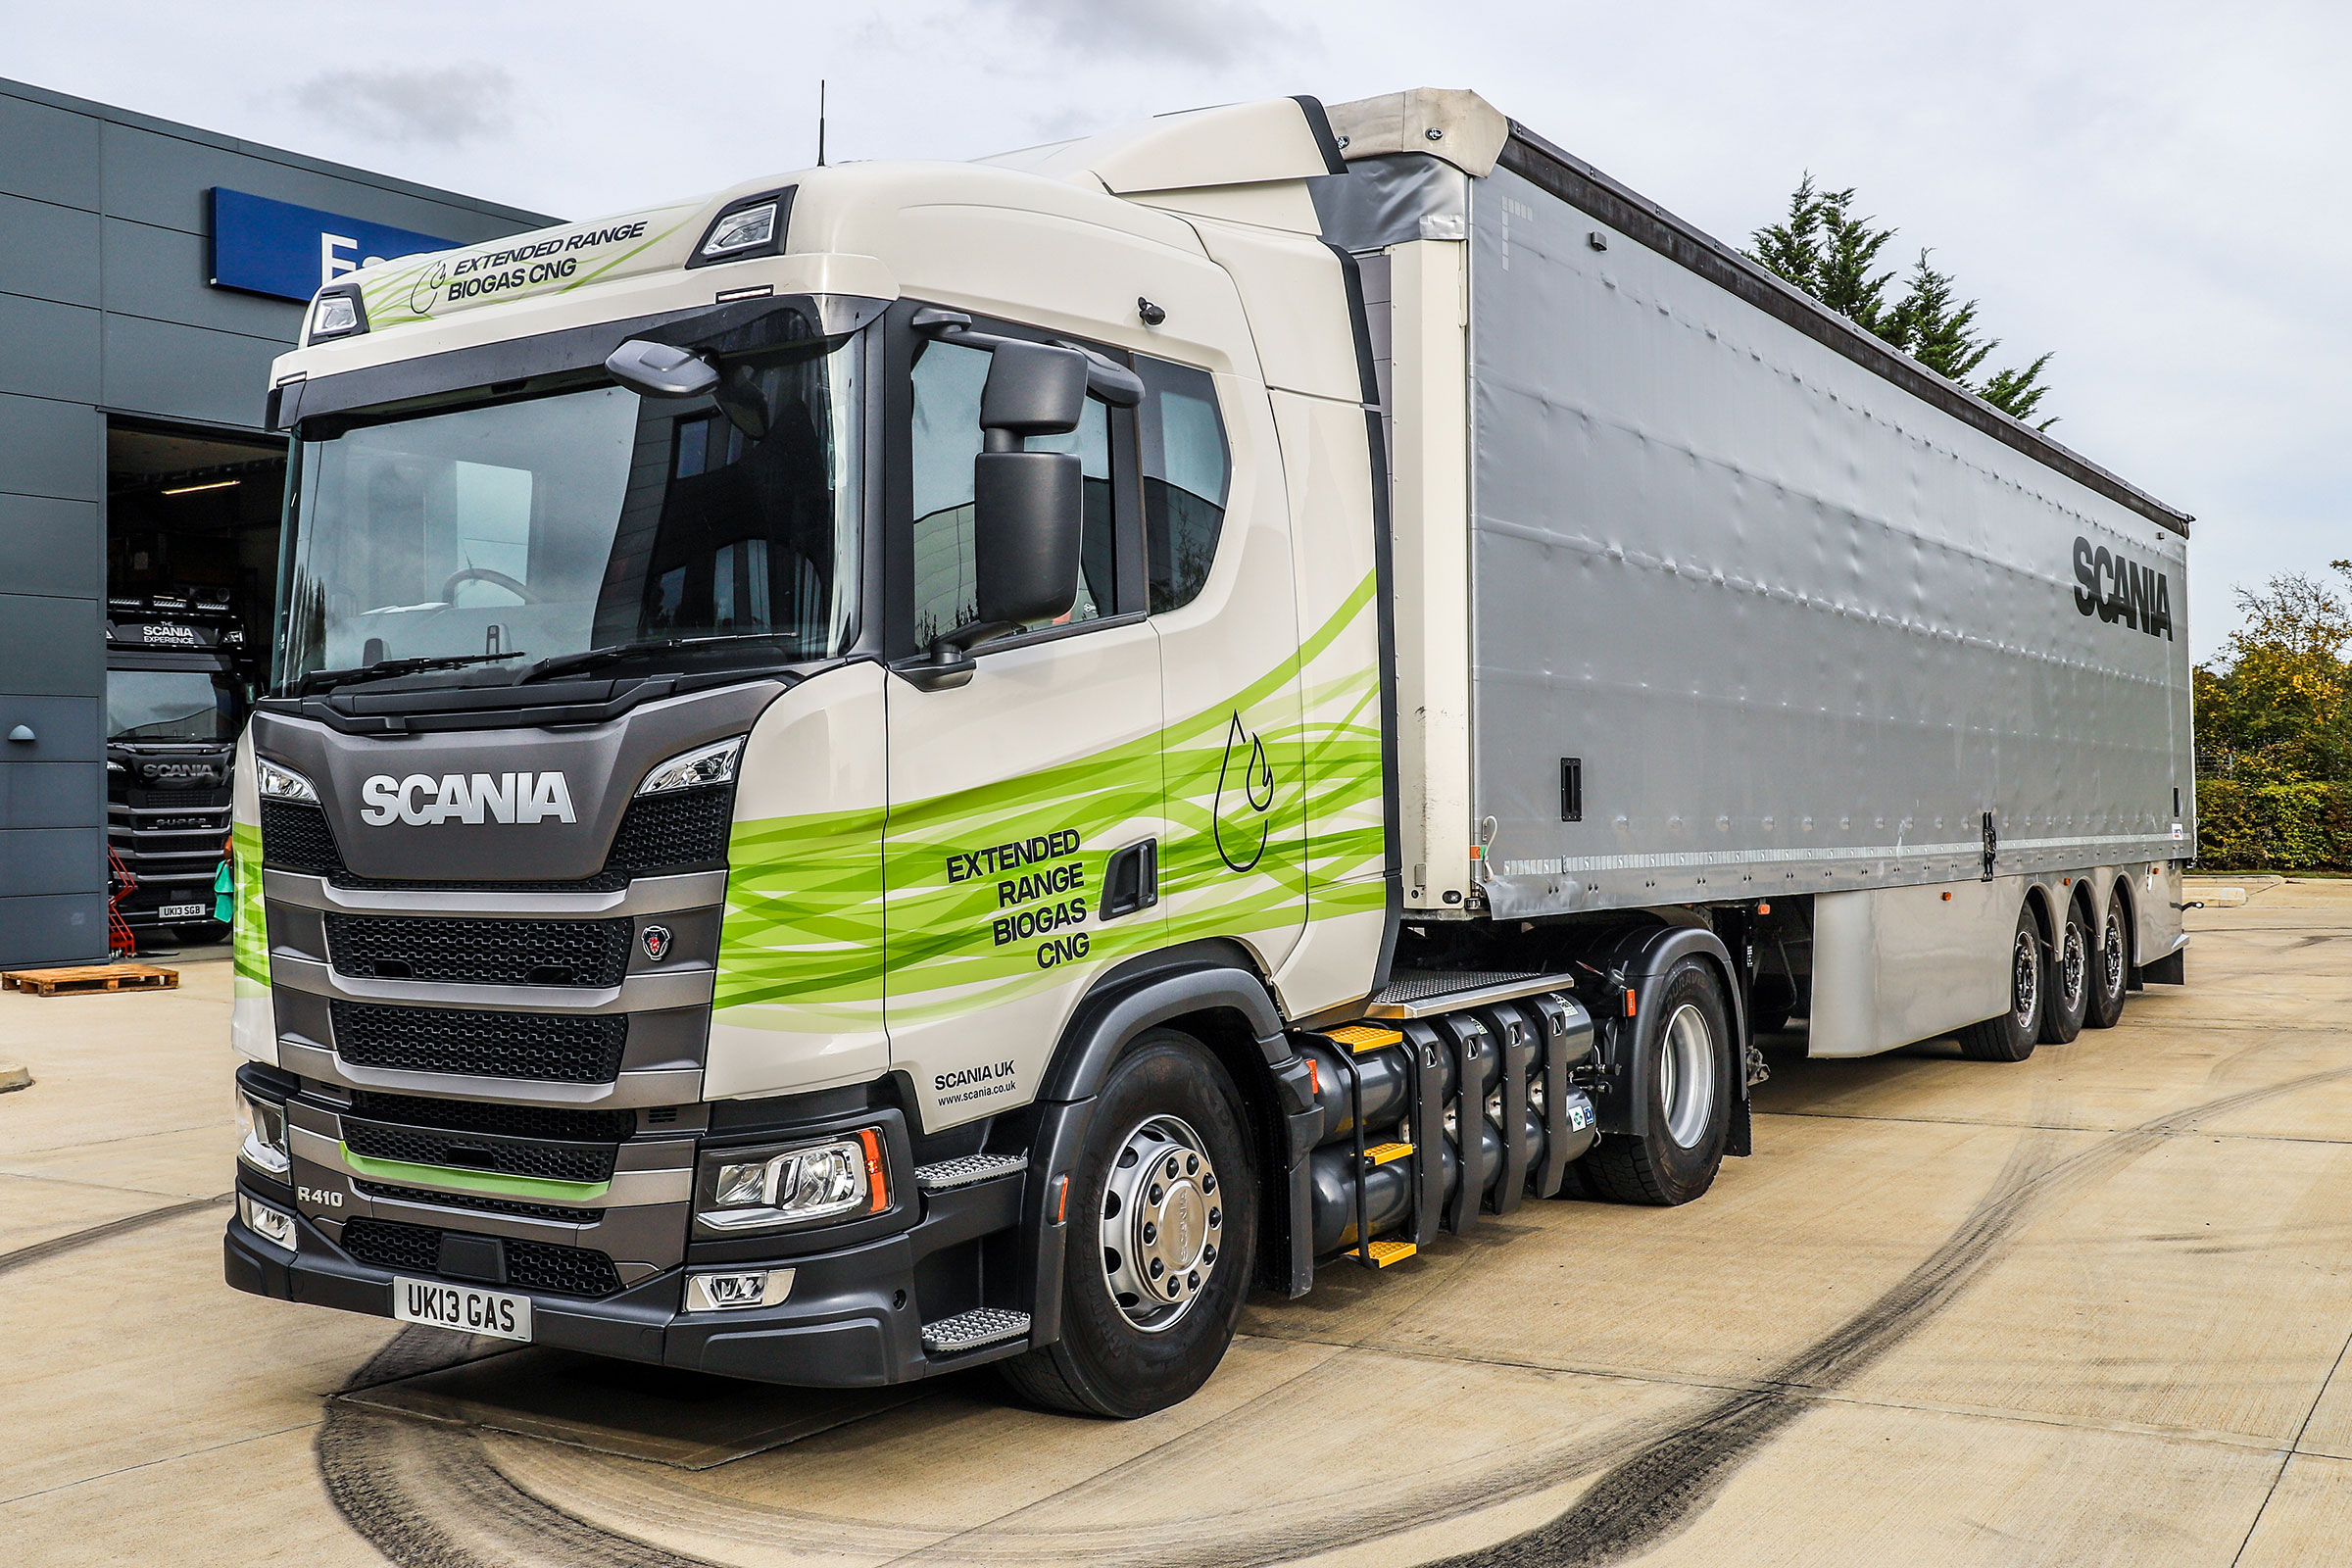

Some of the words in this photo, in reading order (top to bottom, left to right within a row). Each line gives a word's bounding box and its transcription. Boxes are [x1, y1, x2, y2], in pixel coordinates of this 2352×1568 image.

[454, 239, 564, 276] EXTENDED
[564, 220, 648, 251] RANGE
[448, 269, 525, 301] BIOGAS
[528, 258, 577, 283] CNG
[2073, 536, 2173, 642] SCANIA
[143, 626, 194, 637] SCANIA
[143, 763, 214, 777] SCANIA
[361, 771, 578, 827] SCANIA
[157, 817, 208, 826] SUPER
[946, 828, 1081, 883] EXTENDED
[998, 862, 1085, 907] RANGE
[164, 906, 182, 916] UK13
[184, 906, 201, 915] SGB
[993, 898, 1087, 946] BIOGAS
[1037, 932, 1090, 968] CNG
[935, 1065, 993, 1091] SCANIA
[995, 1059, 1015, 1077] UK
[938, 1080, 1016, 1106] www.scania.co.uk
[408, 1284, 461, 1323] UK13
[466, 1294, 515, 1333] GAS
